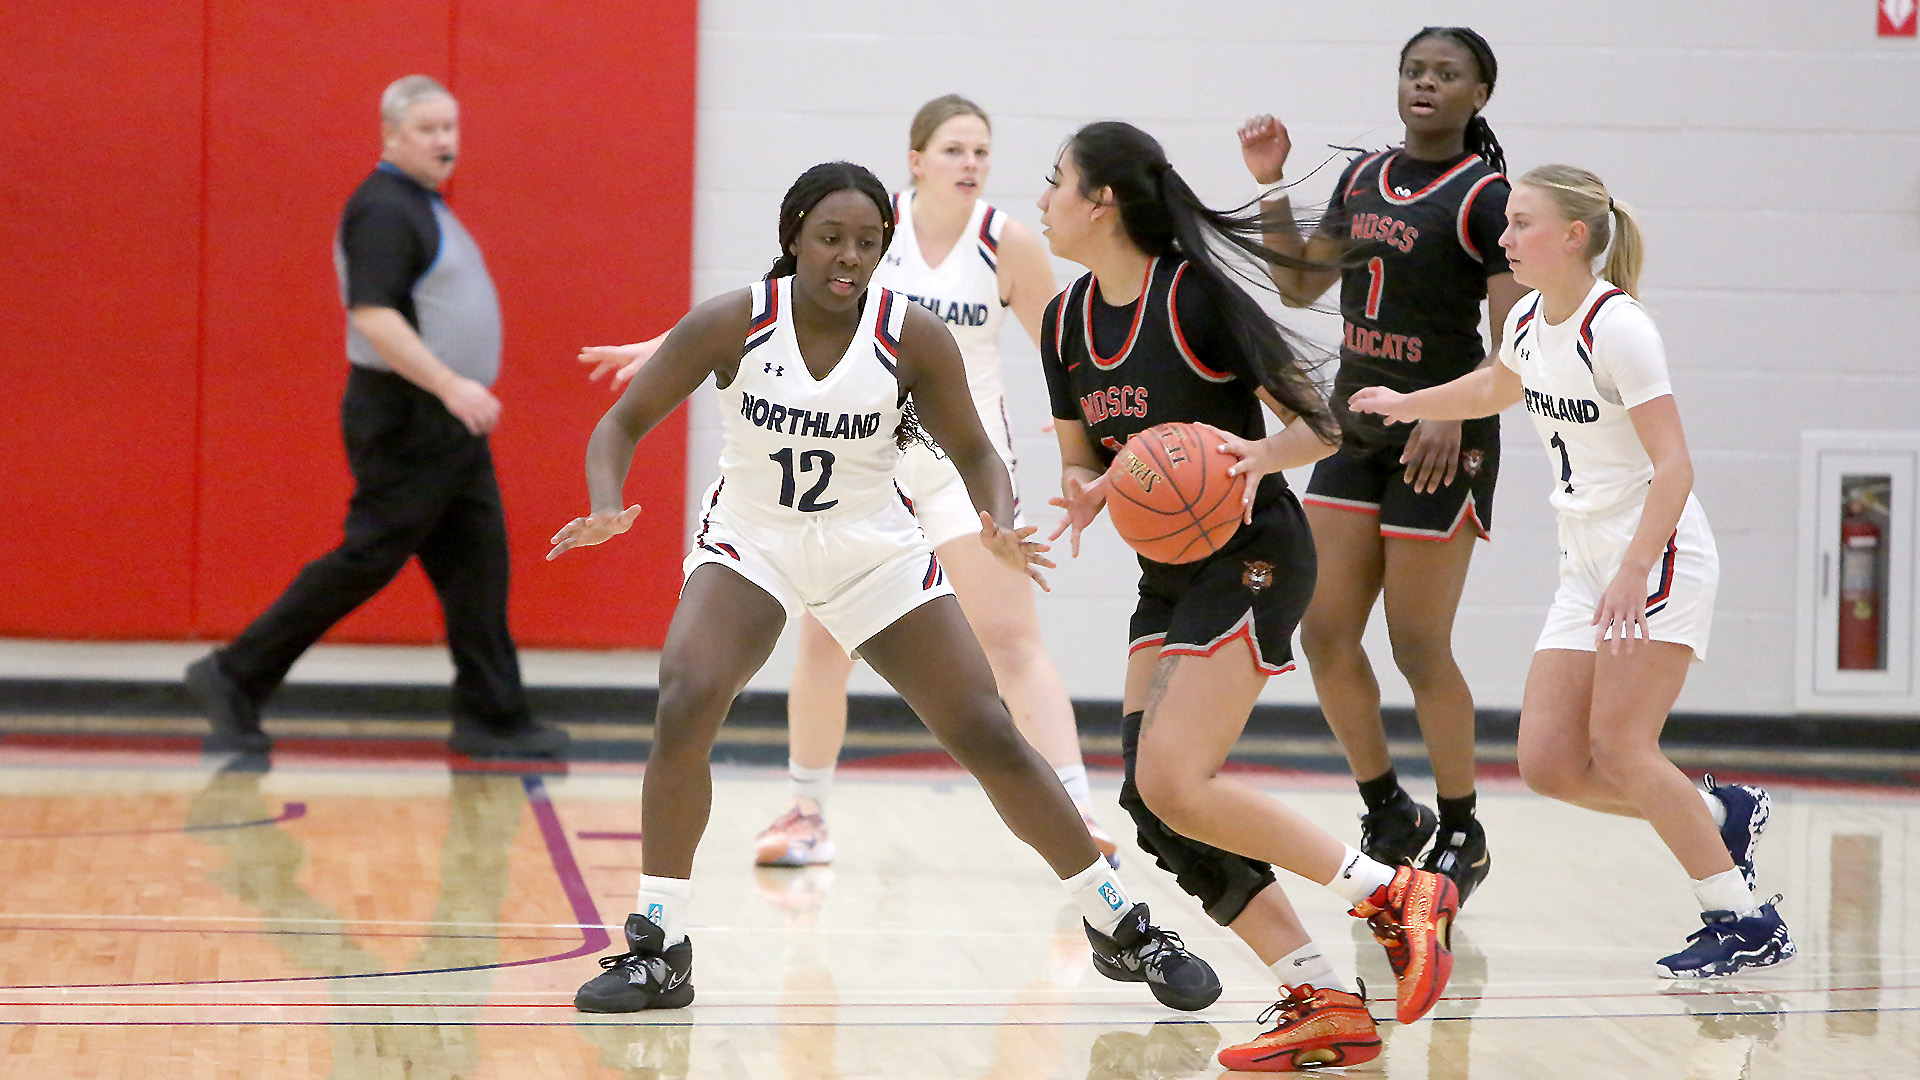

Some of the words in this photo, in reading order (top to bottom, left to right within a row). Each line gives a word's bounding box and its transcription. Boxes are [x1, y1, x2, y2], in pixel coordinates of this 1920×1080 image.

[1351, 213, 1419, 252] NDSCS
[1365, 256, 1384, 320] 1
[1343, 320, 1423, 362] LDCATS
[741, 391, 881, 440] NORTHLAND
[1080, 385, 1149, 427] NDSCS
[1524, 386, 1600, 424] RTHLAND
[768, 447, 839, 513] 12
[1125, 452, 1162, 493] SPAL
[1550, 431, 1575, 494] 1
